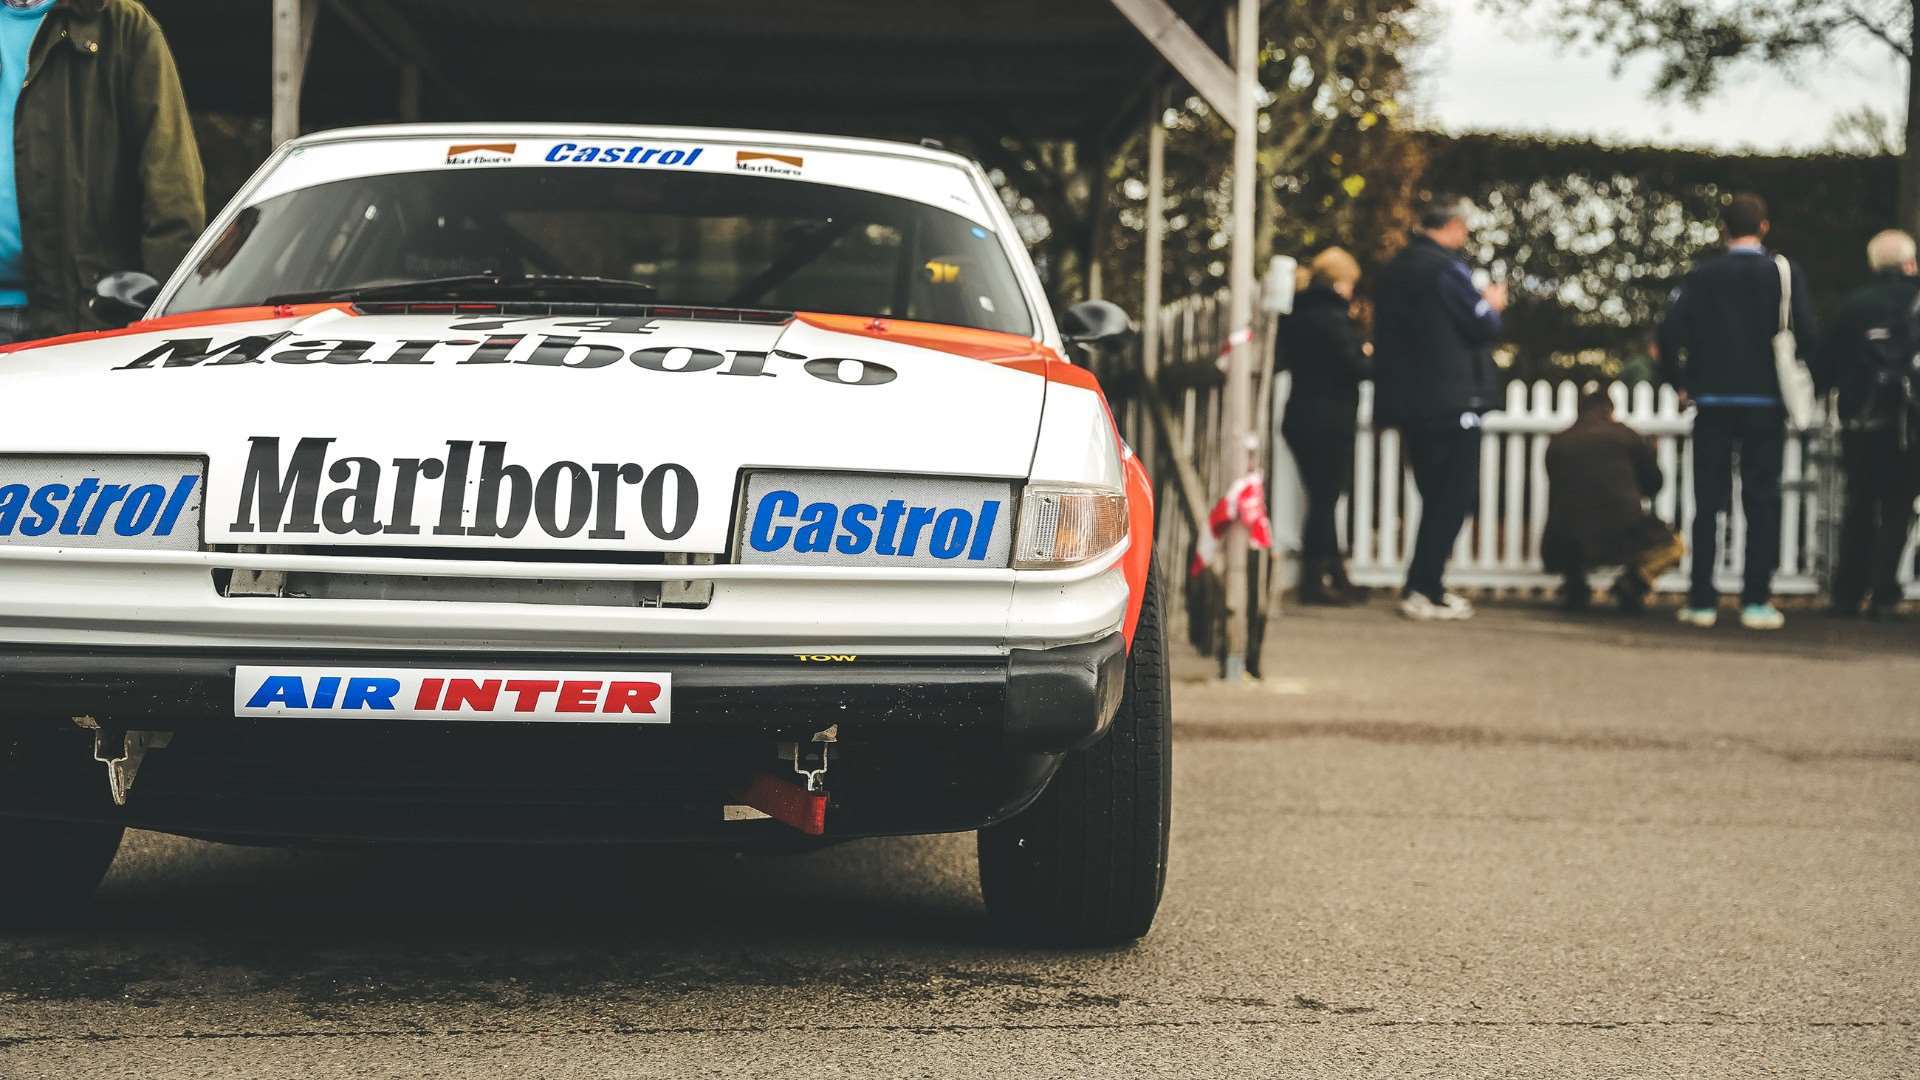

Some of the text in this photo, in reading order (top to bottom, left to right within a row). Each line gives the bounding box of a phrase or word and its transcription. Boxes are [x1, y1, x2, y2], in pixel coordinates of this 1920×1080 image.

[545, 143, 703, 166] Castrol
[111, 333, 898, 385] Marlboro
[0, 474, 199, 537] astrol
[229, 436, 699, 541] Marlboro
[750, 490, 1001, 560] Castrol
[794, 654, 857, 662] TOW
[245, 675, 662, 714] AIR INTER
